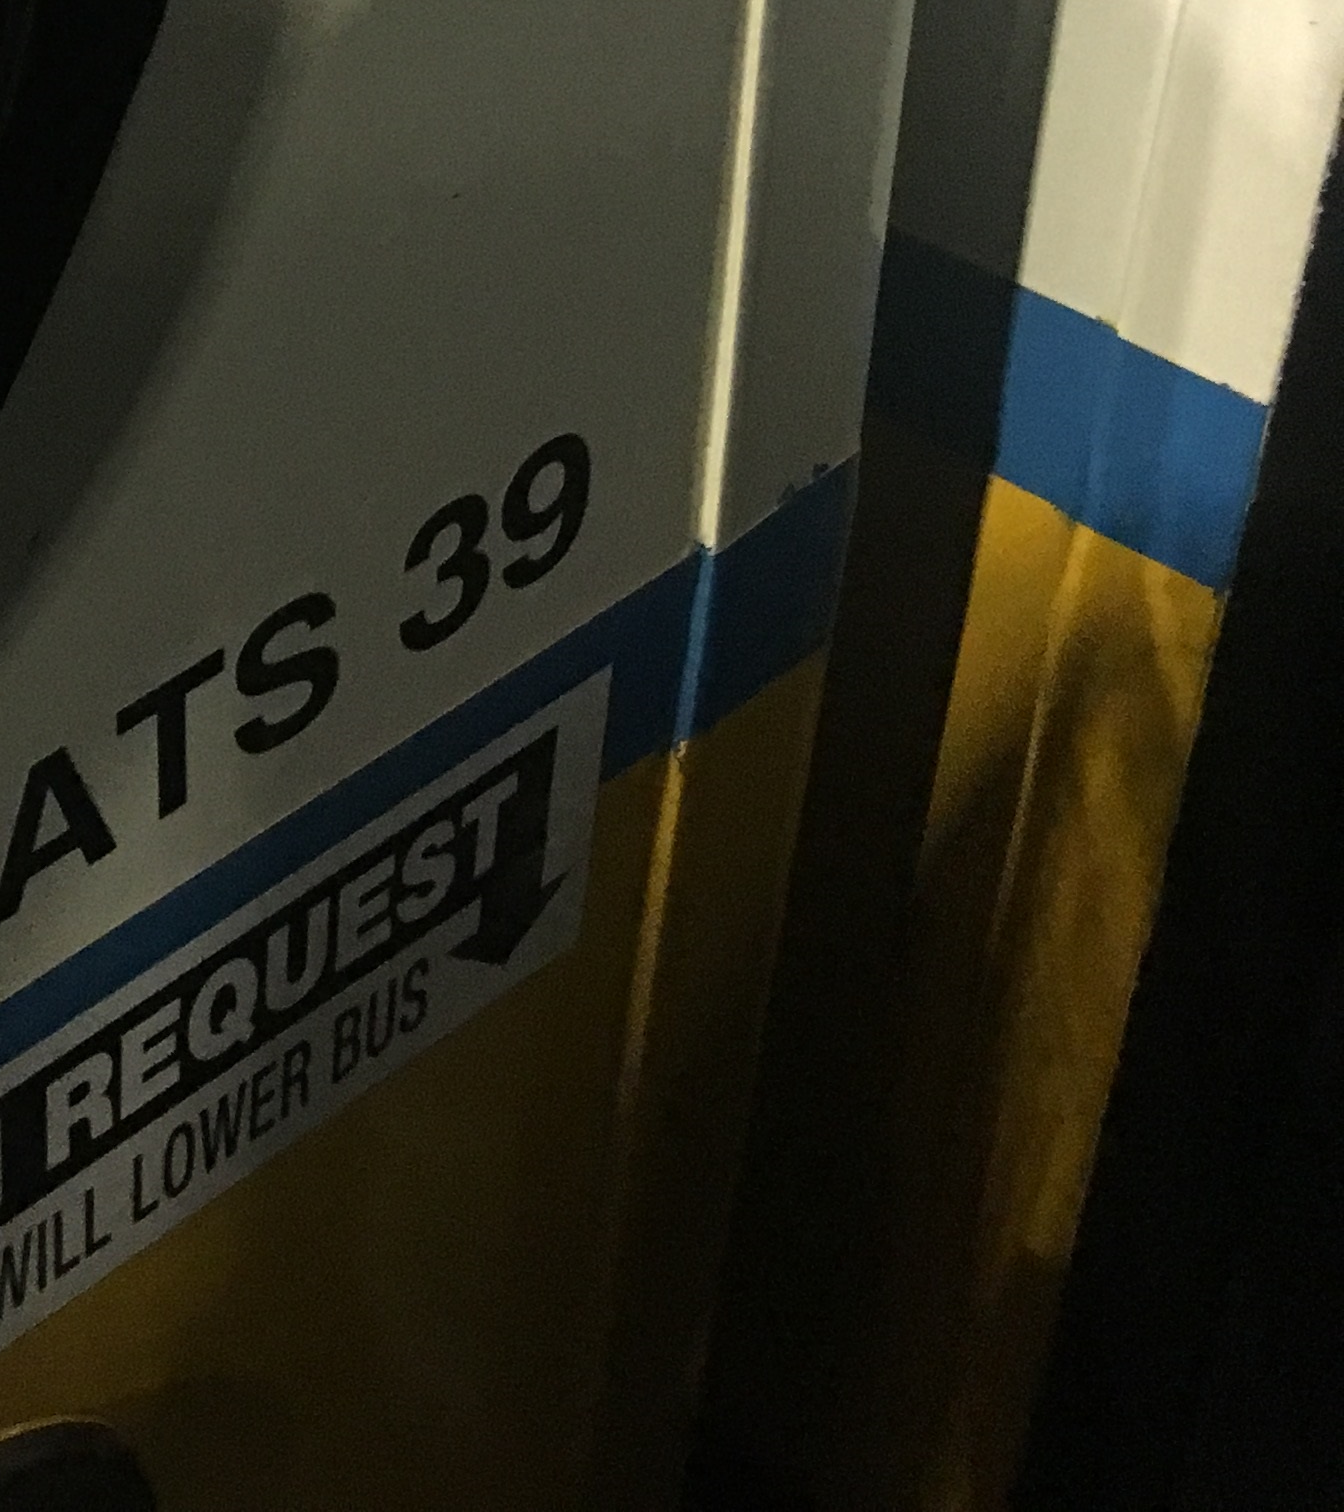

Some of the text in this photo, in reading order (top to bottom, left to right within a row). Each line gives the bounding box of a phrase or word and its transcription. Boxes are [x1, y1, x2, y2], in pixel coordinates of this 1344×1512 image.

[399, 432, 591, 651] 39
[45, 771, 519, 1172] REQUEST
[133, 1040, 311, 1223] LOWER
[332, 957, 428, 1083] BUS
